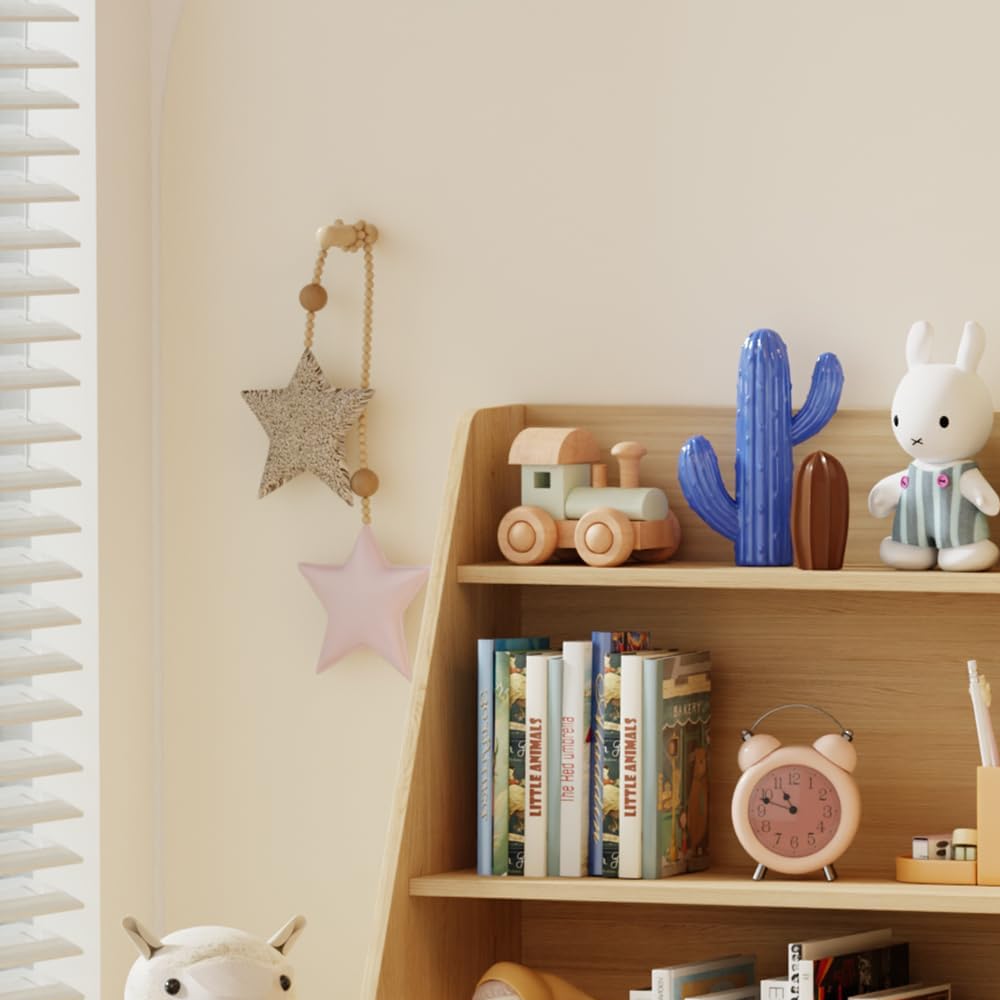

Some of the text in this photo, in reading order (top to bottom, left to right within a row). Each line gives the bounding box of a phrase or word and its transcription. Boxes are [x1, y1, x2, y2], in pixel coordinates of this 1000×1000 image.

[529, 717, 542, 817] LITTLE ANIMALS
[624, 717, 637, 817] LITTLE ANIMALS
